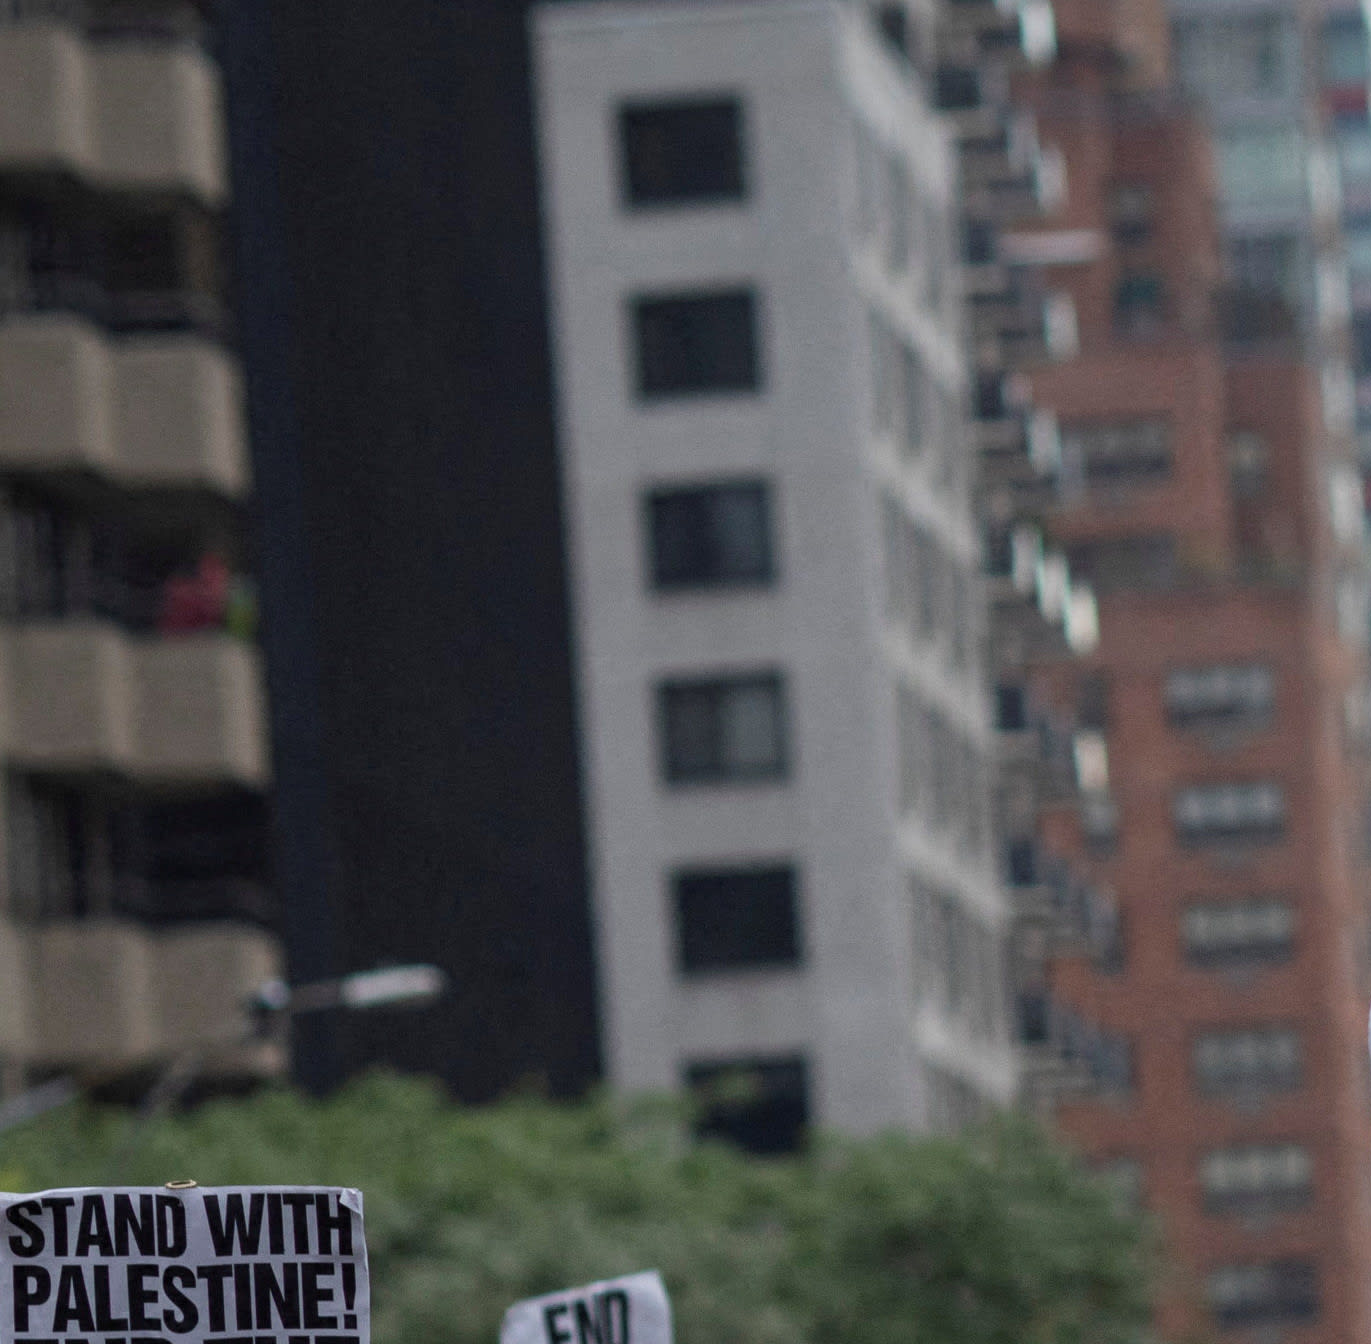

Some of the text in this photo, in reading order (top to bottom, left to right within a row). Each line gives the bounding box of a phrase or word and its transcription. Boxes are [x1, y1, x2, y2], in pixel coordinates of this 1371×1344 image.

[8, 1191, 354, 1258] STAND WITH
[14, 1262, 358, 1334] PALESTINE!
